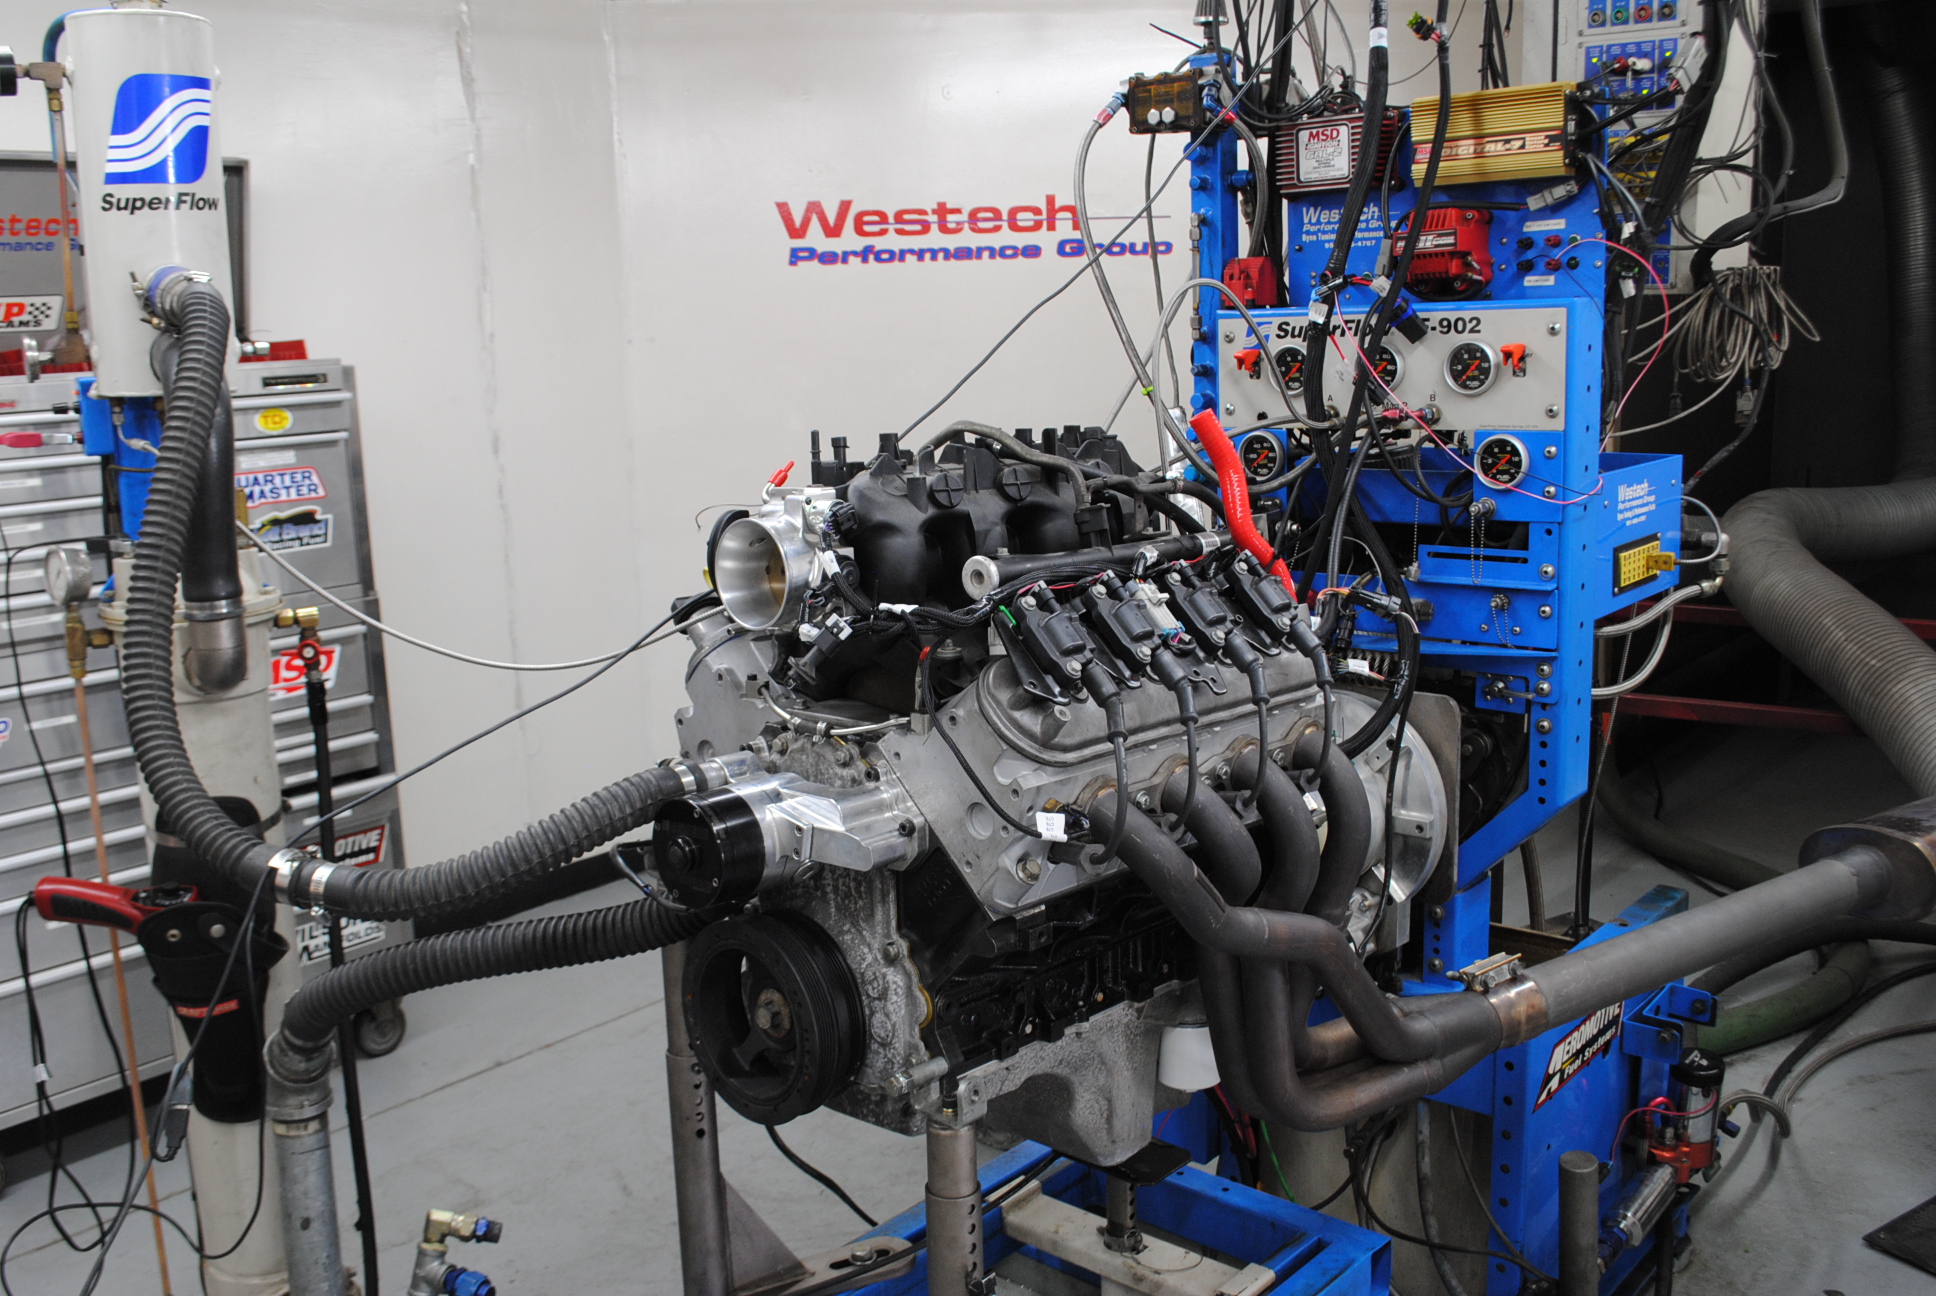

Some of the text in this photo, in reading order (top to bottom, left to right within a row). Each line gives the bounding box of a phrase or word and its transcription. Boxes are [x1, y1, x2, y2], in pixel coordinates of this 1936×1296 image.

[1308, 128, 1340, 143] MSD
[1441, 139, 1524, 157] DIGITAL-7
[101, 193, 219, 215] SuperFlow
[775, 194, 1081, 239] Westech
[1303, 203, 1379, 224] Wesch
[1318, 232, 1336, 240] Tunin
[788, 238, 1173, 266] Performance Group
[0, 302, 27, 322] P
[0, 320, 42, 328] AMS
[1327, 394, 1334, 402] A
[1429, 394, 1437, 402] B
[236, 471, 313, 488] UARTER
[1618, 479, 1649, 502] Westech
[268, 540, 302, 550] acing
[1564, 1025, 1616, 1079] Fuel Systems
